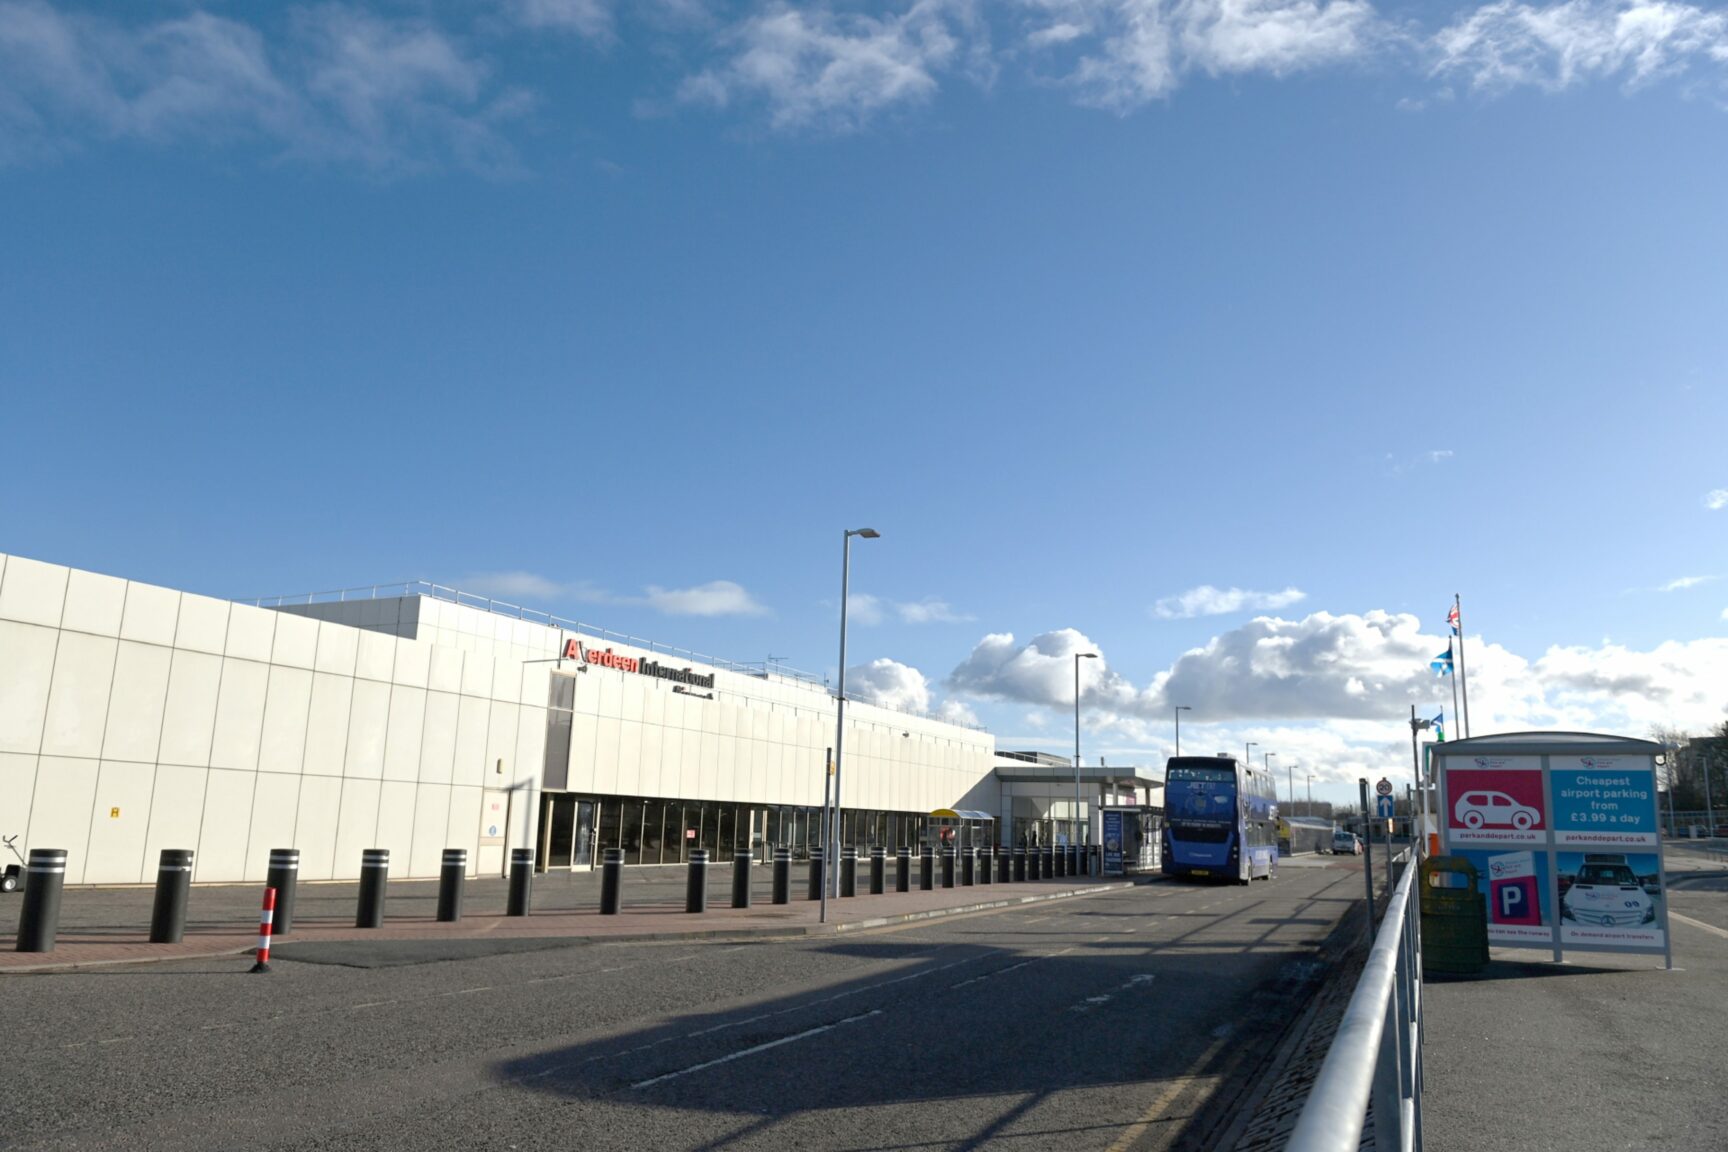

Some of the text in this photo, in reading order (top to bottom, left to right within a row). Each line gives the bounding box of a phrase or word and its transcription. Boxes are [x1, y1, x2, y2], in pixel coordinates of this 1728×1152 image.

[639, 657, 715, 689] International
[1576, 776, 1631, 787] Cheapest
[1561, 789, 1648, 800] airport parking
[1591, 801, 1618, 810] from
[1571, 813, 1641, 825] £3.99 a day
[1460, 832, 1536, 841] parkanddepart.co.uk
[1566, 834, 1646, 843] parkanddepart.co.uk
[1502, 886, 1522, 916] P
